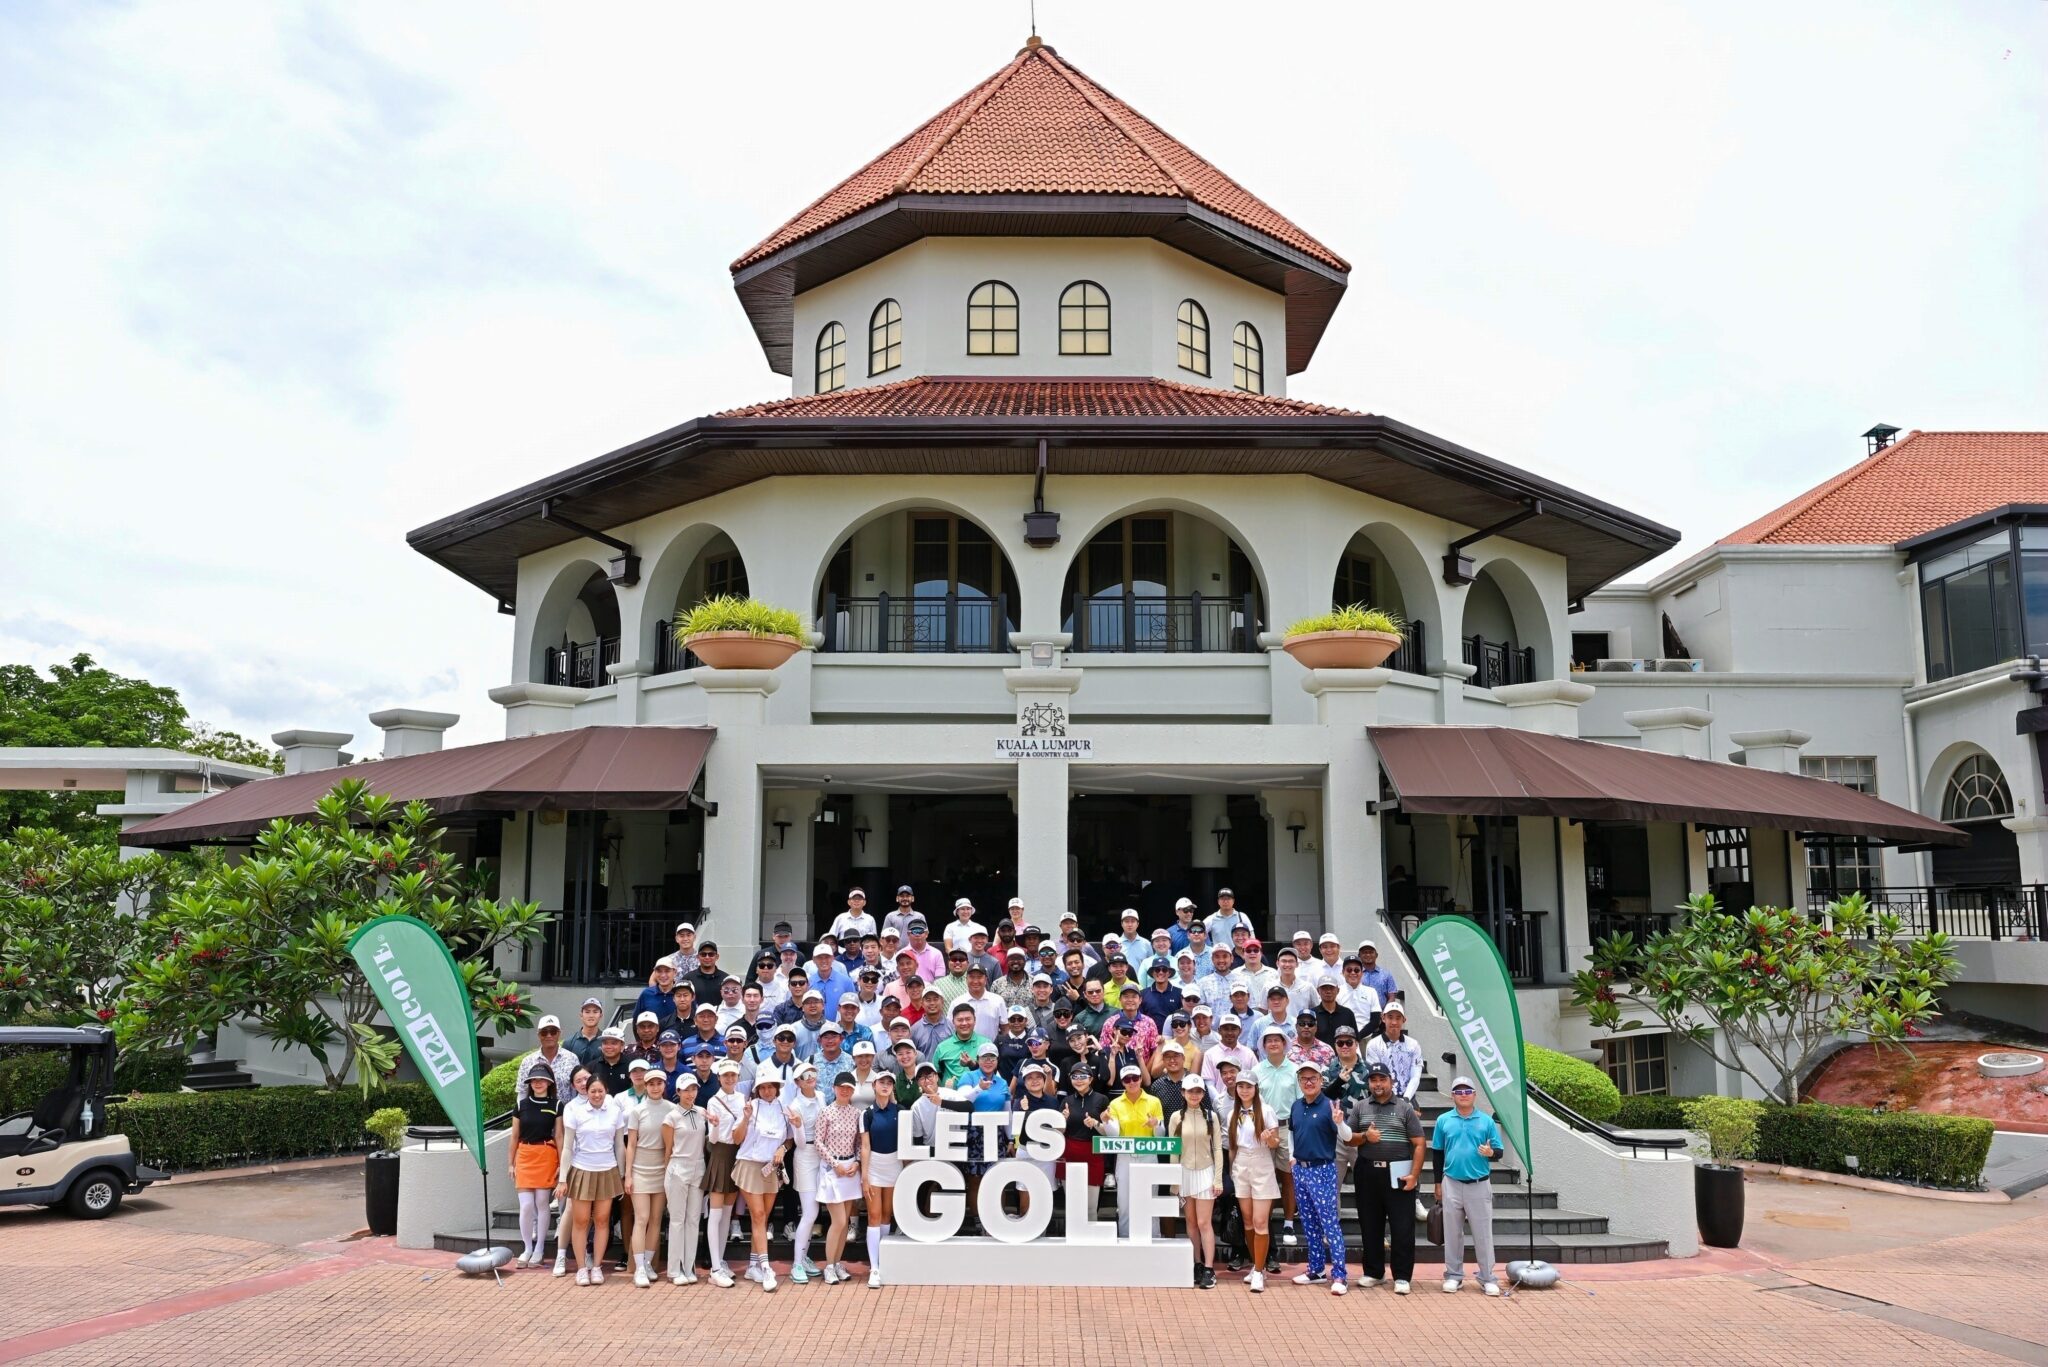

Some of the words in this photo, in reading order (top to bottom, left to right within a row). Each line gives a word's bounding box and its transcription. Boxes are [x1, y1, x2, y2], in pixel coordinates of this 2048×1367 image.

[997, 740, 1038, 750] KUALA
[1042, 740, 1091, 750] LUMPUR
[897, 1109, 1066, 1162] LET'S
[1102, 1141, 1133, 1151] MST
[1135, 1141, 1176, 1151] GOLF
[893, 1160, 1182, 1245] GOLF
